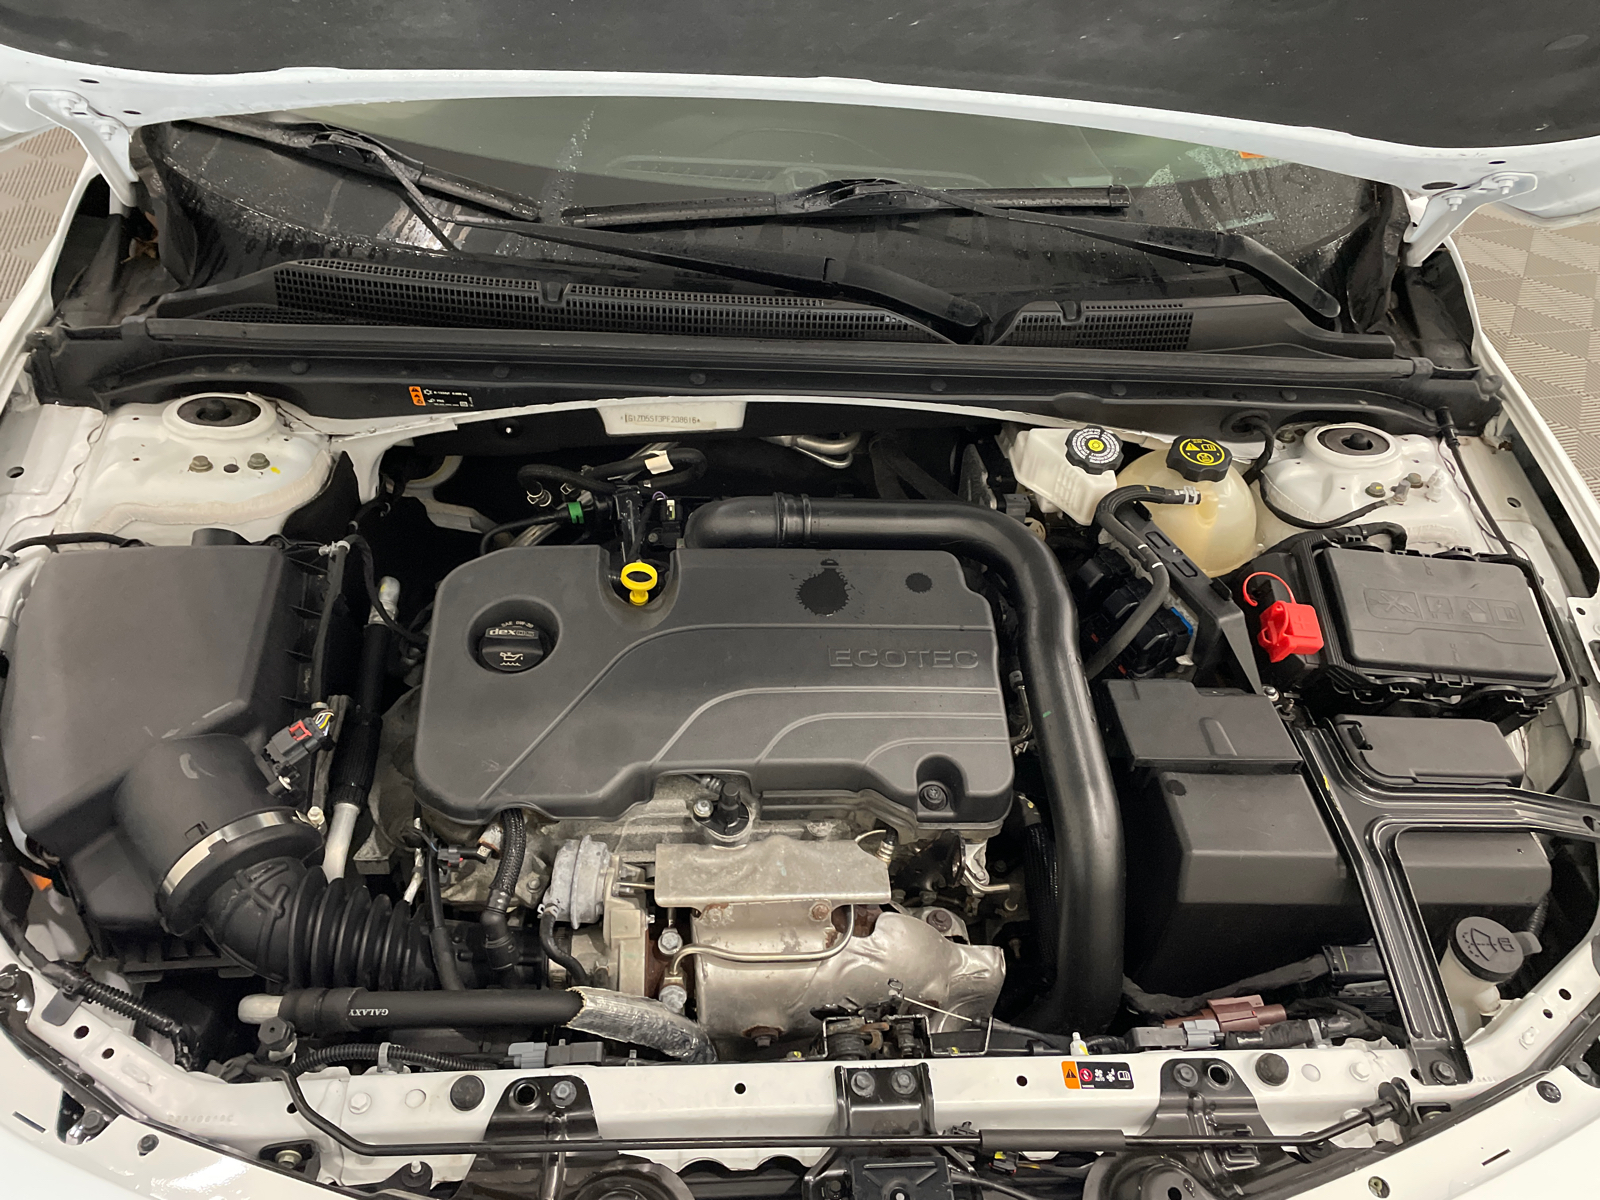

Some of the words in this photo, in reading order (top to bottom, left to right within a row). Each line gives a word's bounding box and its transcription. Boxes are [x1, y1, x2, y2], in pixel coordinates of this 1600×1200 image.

[489, 628, 535, 637] dexos
[828, 649, 979, 668] ECOTEC
[349, 1008, 389, 1016] GALAXY
